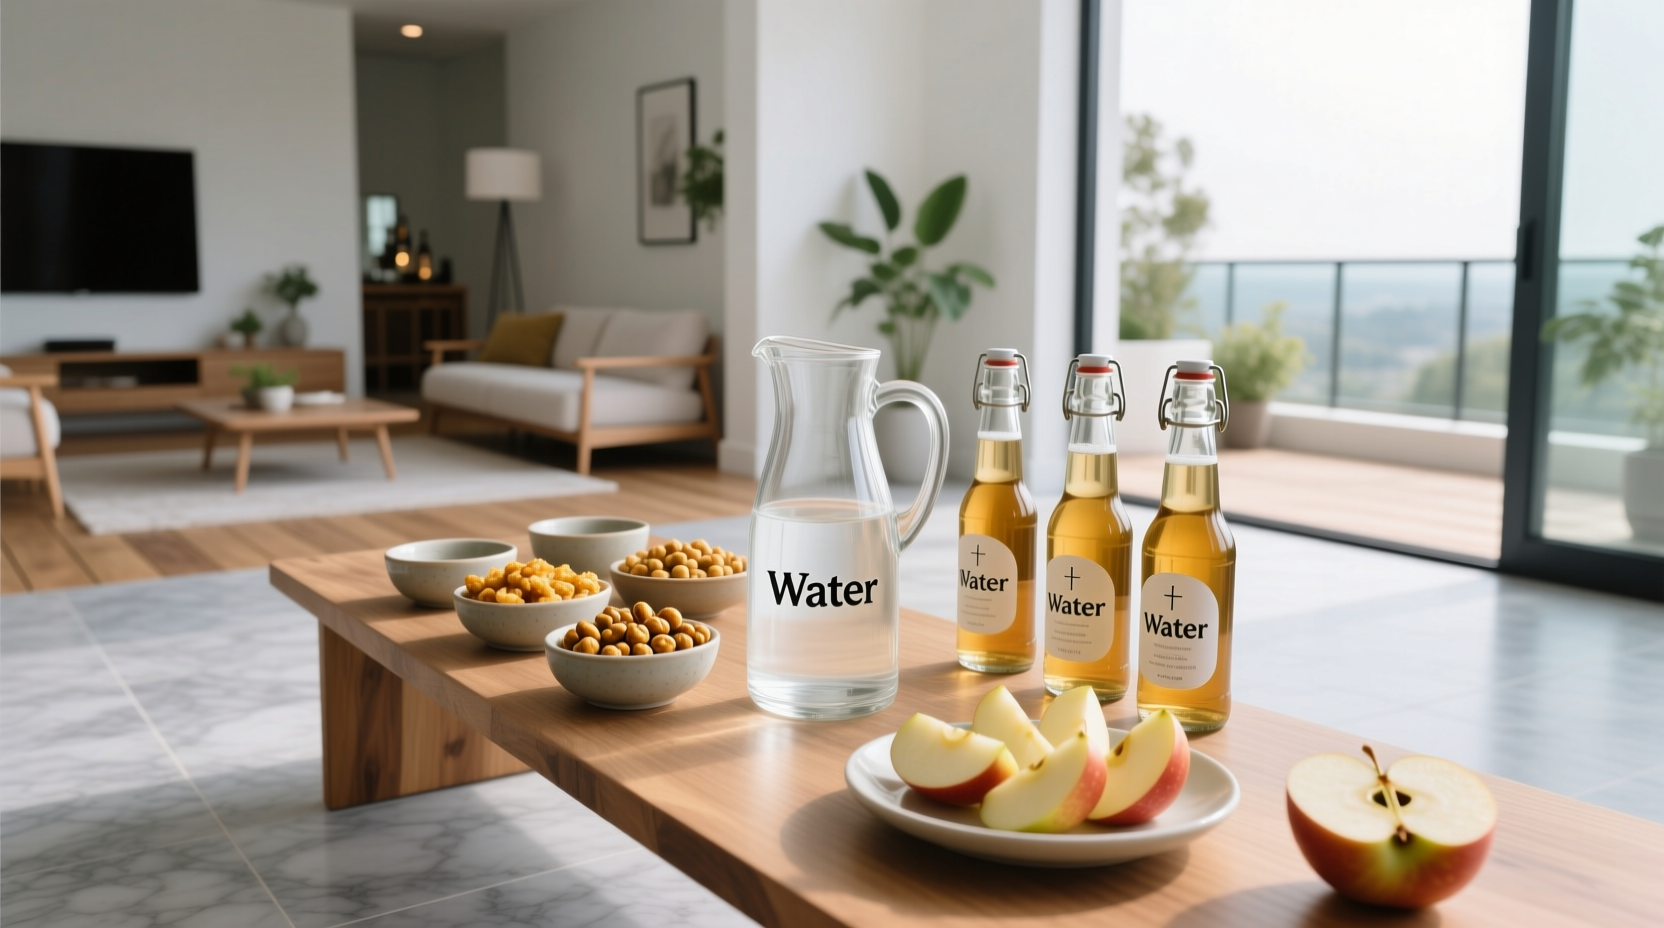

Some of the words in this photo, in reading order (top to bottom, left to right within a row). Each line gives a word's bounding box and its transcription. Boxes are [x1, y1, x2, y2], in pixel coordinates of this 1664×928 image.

[767, 570, 878, 607] Water
[960, 569, 1009, 591] Water
[1048, 592, 1106, 617] Water
[1144, 612, 1208, 639] Water
